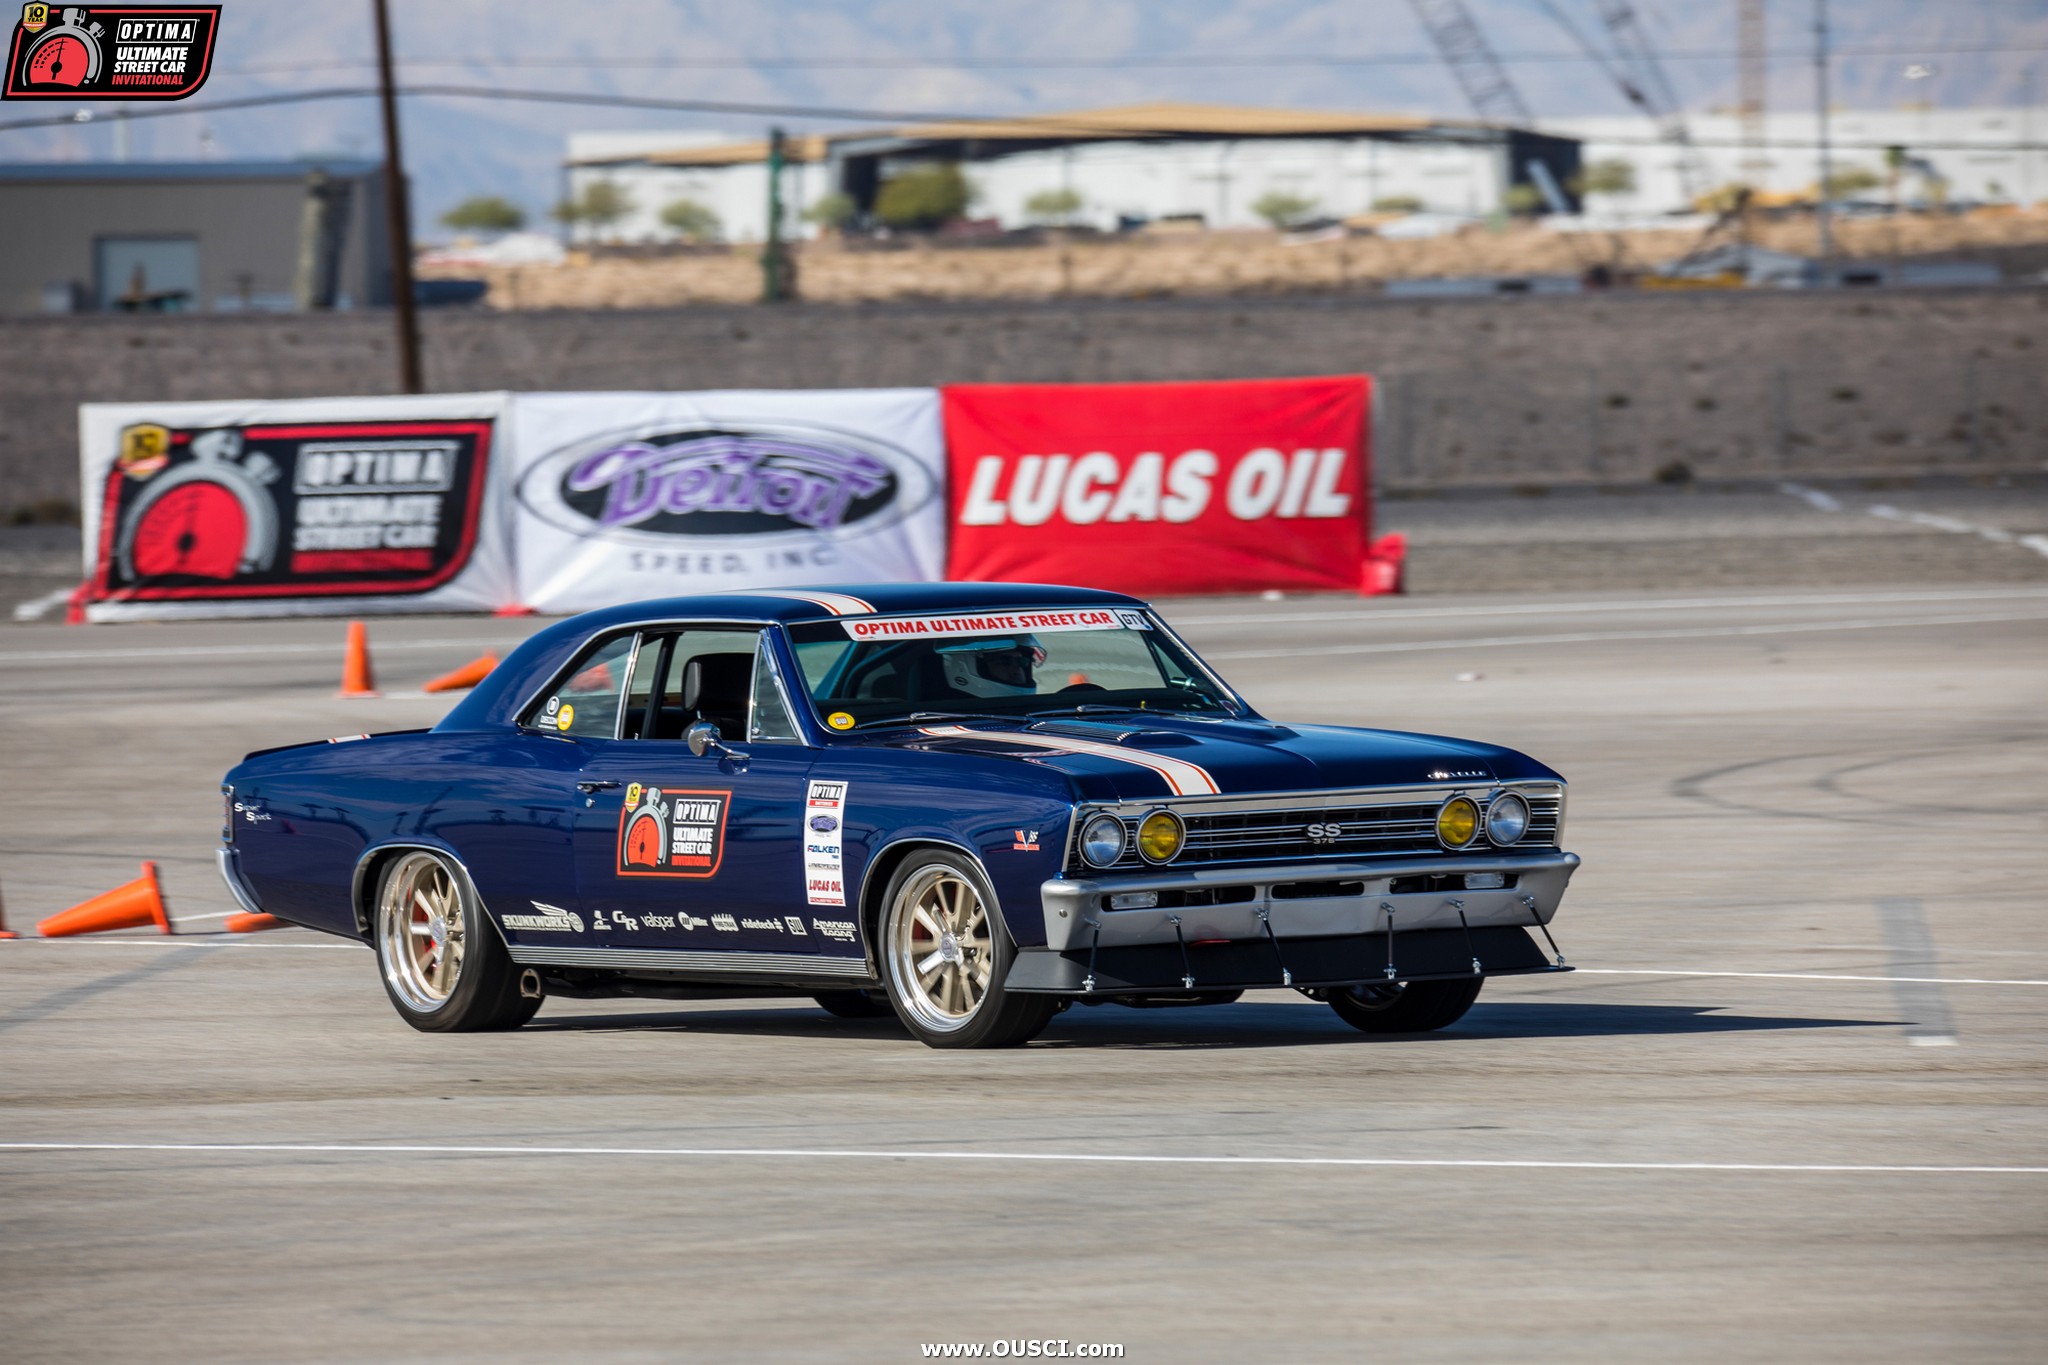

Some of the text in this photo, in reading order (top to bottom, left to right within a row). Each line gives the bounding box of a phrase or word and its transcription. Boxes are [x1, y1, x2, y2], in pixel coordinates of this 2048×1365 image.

[303, 451, 444, 485] OPTIMA
[960, 447, 1352, 526] LUCAS OIL
[854, 612, 1114, 635] OPTIMA ULTIMATE STREET CAR
[811, 784, 842, 799] OPTIMA
[676, 803, 716, 820] OPTIMA
[673, 827, 713, 841] ULTIMATE
[1307, 823, 1341, 837] SS
[672, 842, 712, 854] STREET CAR
[807, 845, 840, 853] FALKEN
[809, 880, 842, 892] LUCAS OIL
[640, 911, 676, 931] valspar
[741, 918, 776, 929] ridetech
[813, 918, 857, 930] American
